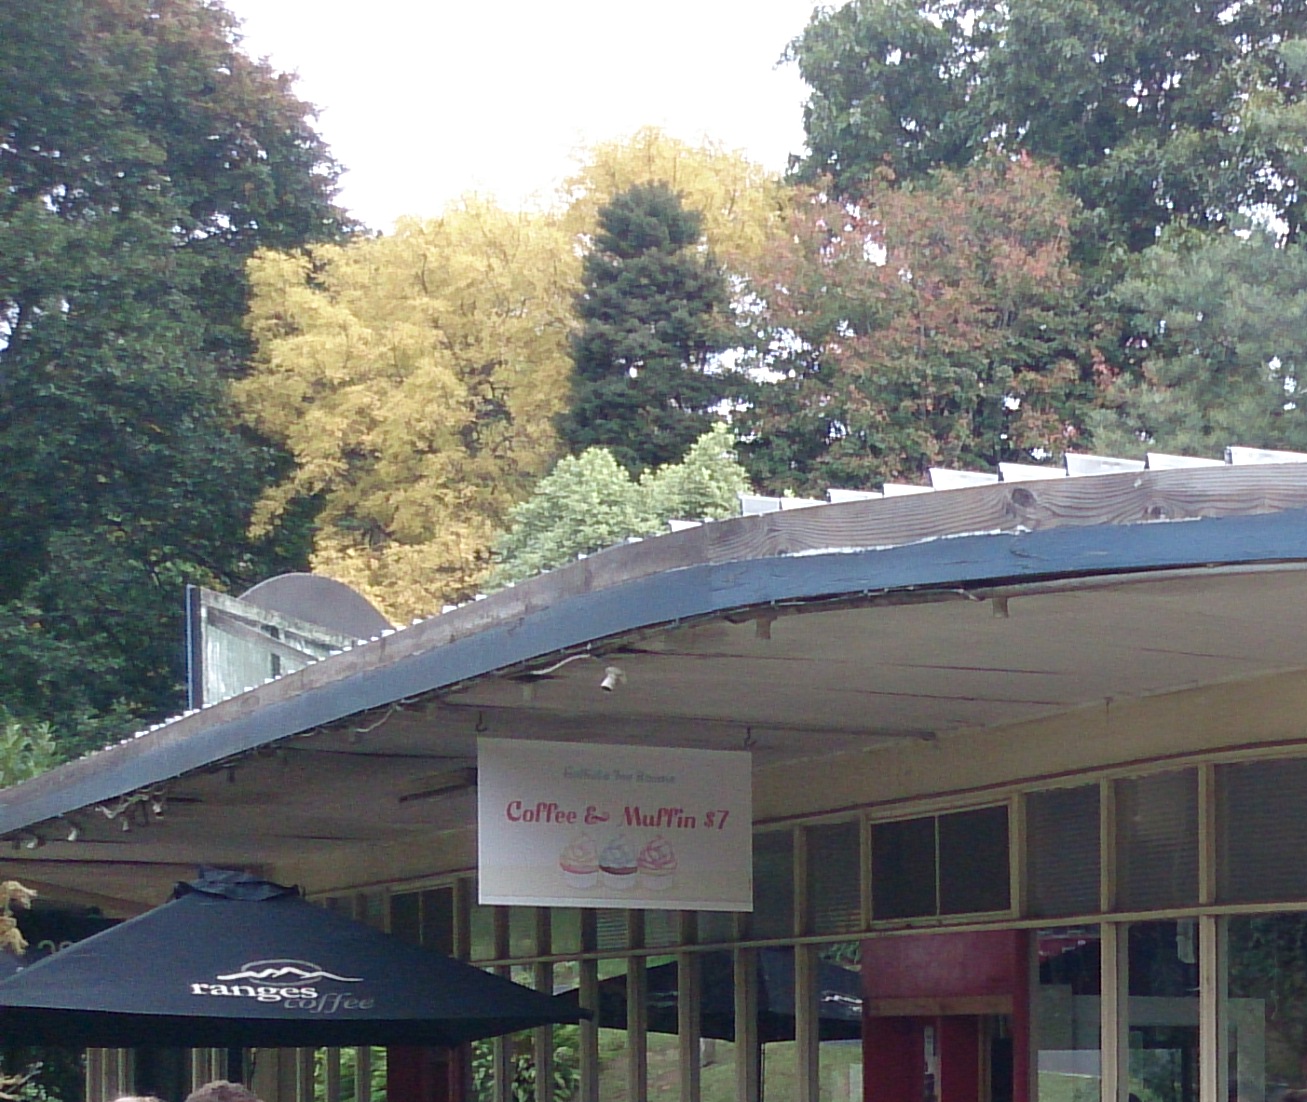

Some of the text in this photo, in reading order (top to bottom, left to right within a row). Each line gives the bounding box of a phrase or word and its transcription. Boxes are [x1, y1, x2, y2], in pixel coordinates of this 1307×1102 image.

[506, 801, 577, 824] Coffee
[624, 806, 697, 829] Muffin
[703, 809, 730, 830] $7
[190, 983, 318, 1002] ranges
[284, 993, 375, 1014] coffee
